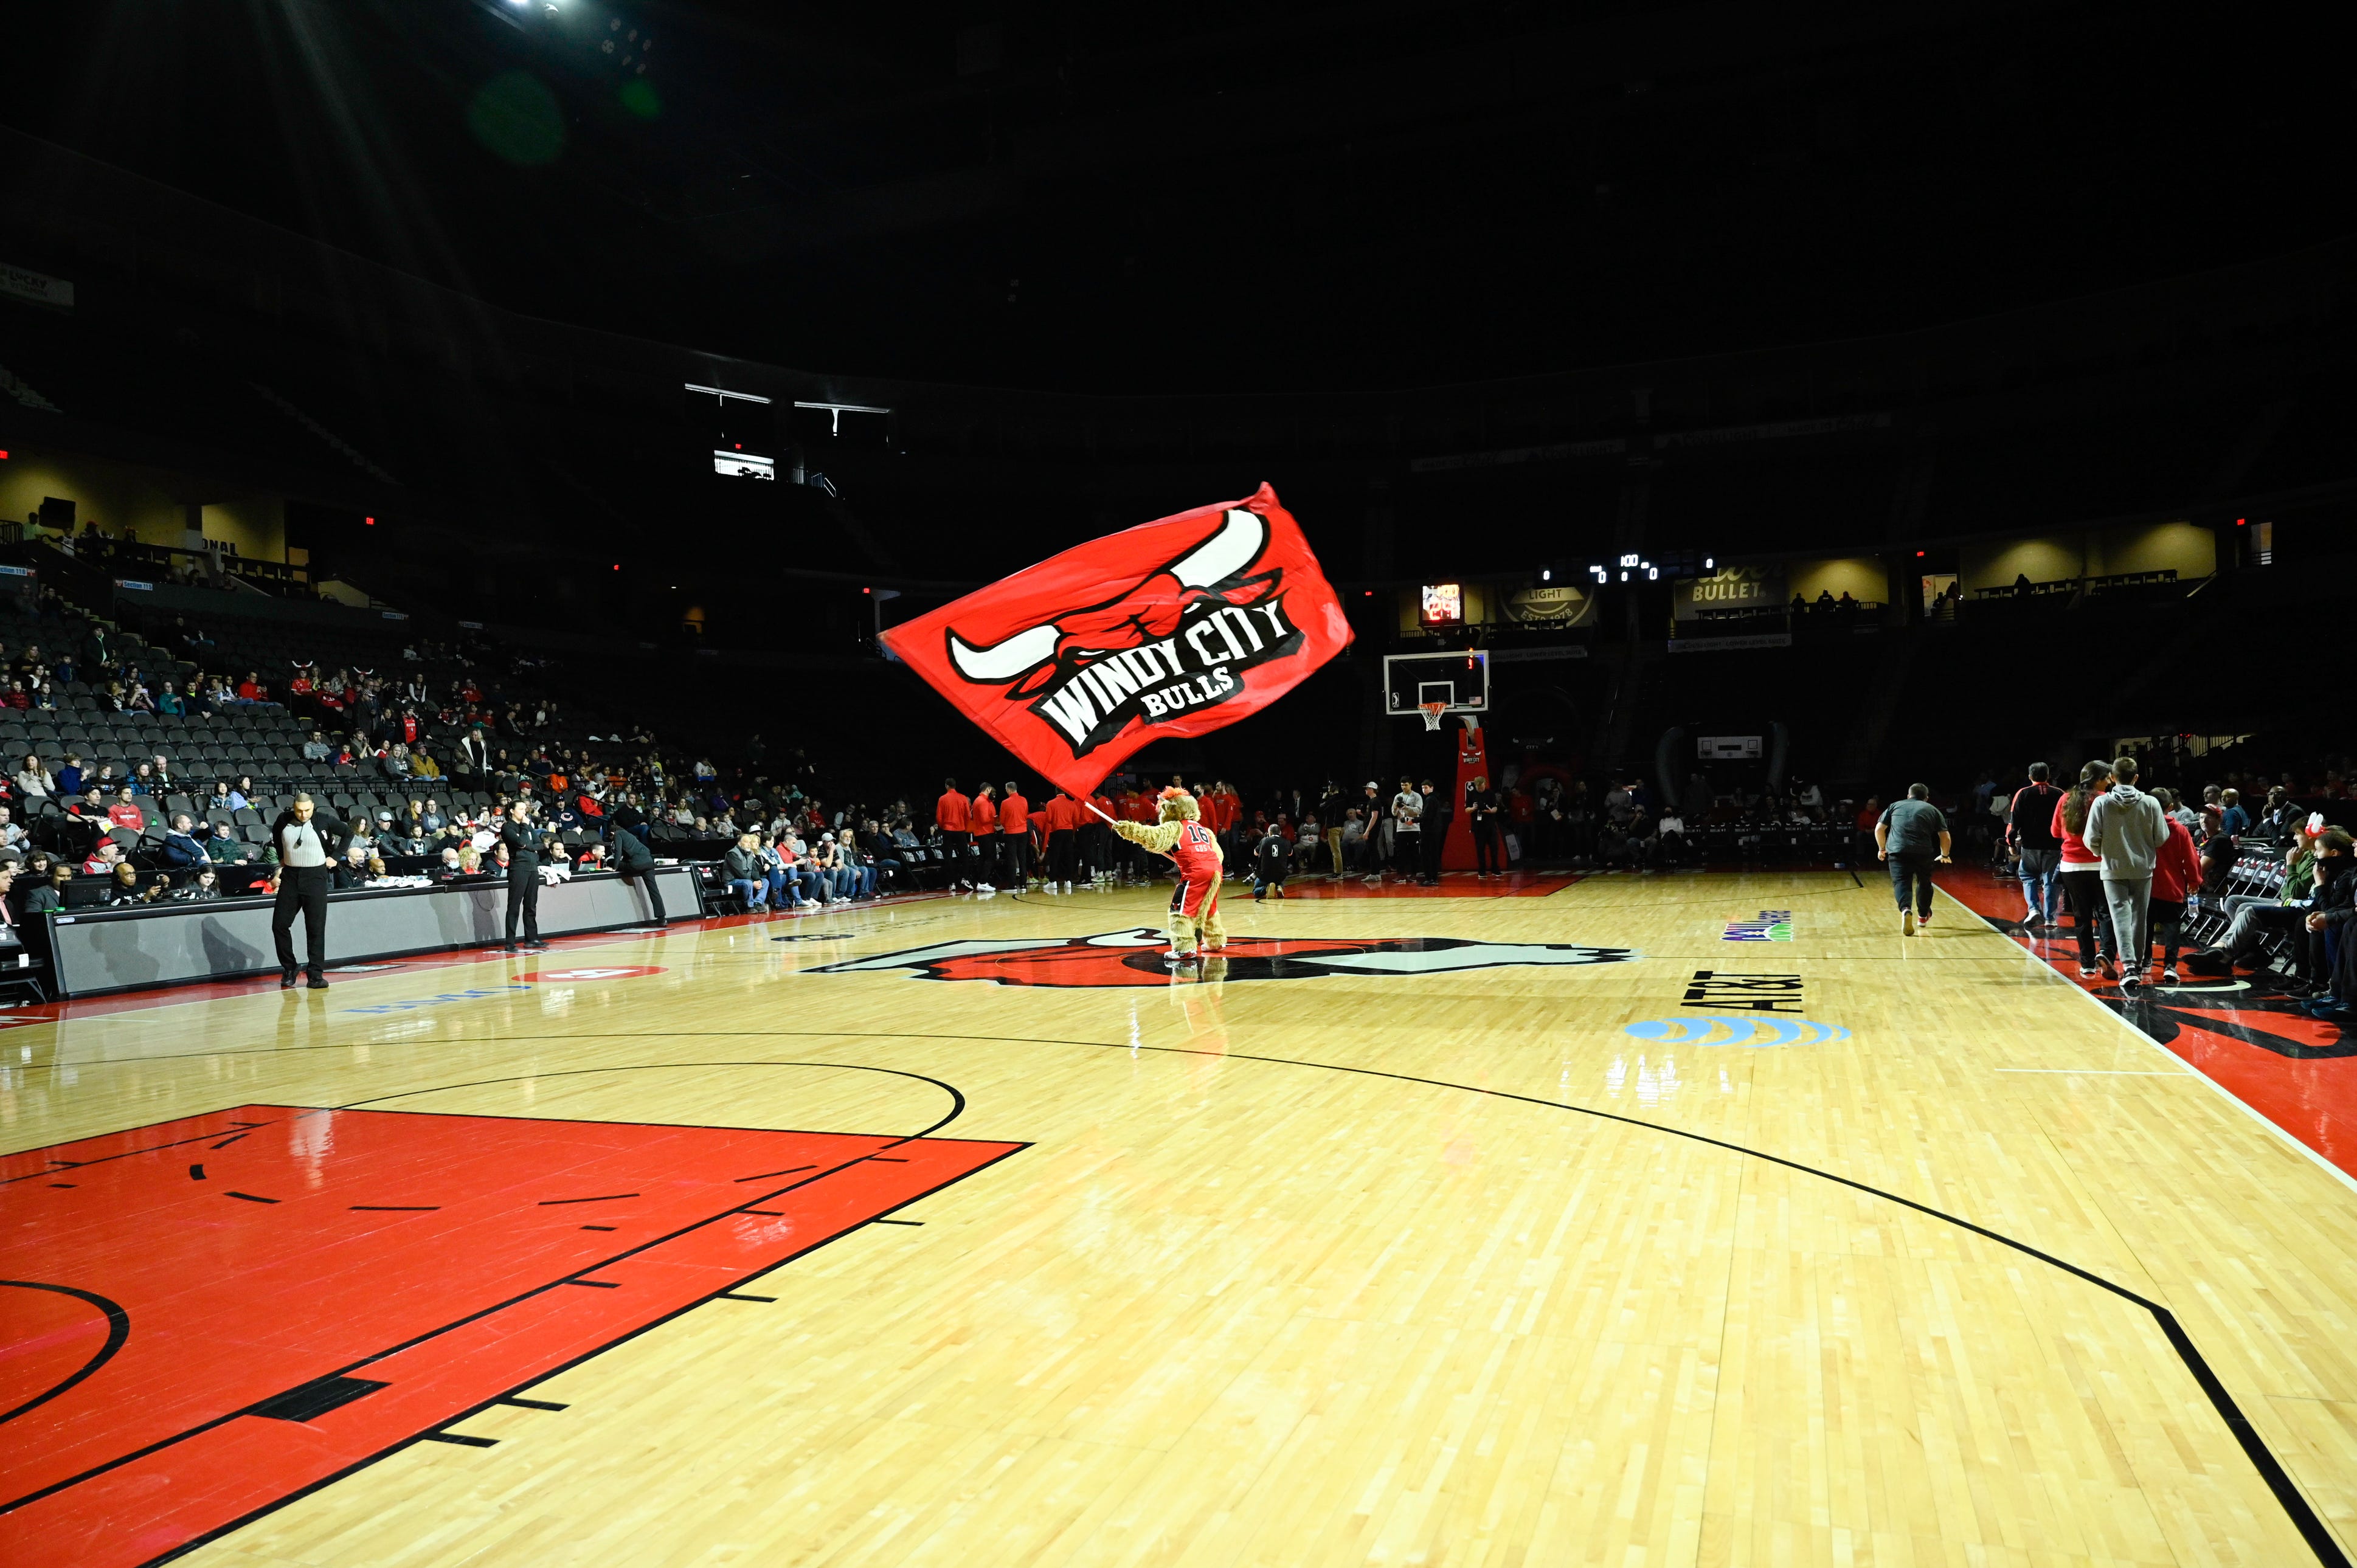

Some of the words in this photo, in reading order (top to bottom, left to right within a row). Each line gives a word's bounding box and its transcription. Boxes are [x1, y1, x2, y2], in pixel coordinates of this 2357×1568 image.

[1529, 589, 1562, 599] LIGHT
[1692, 582, 1762, 602] BULLET
[1040, 638, 1185, 747] WINDY
[1185, 599, 1289, 666] CITY
[1140, 666, 1235, 718] BULLS
[1187, 824, 1210, 845] 16
[337, 985, 533, 1014] BMO
[1680, 970, 1804, 1013] AT&T
